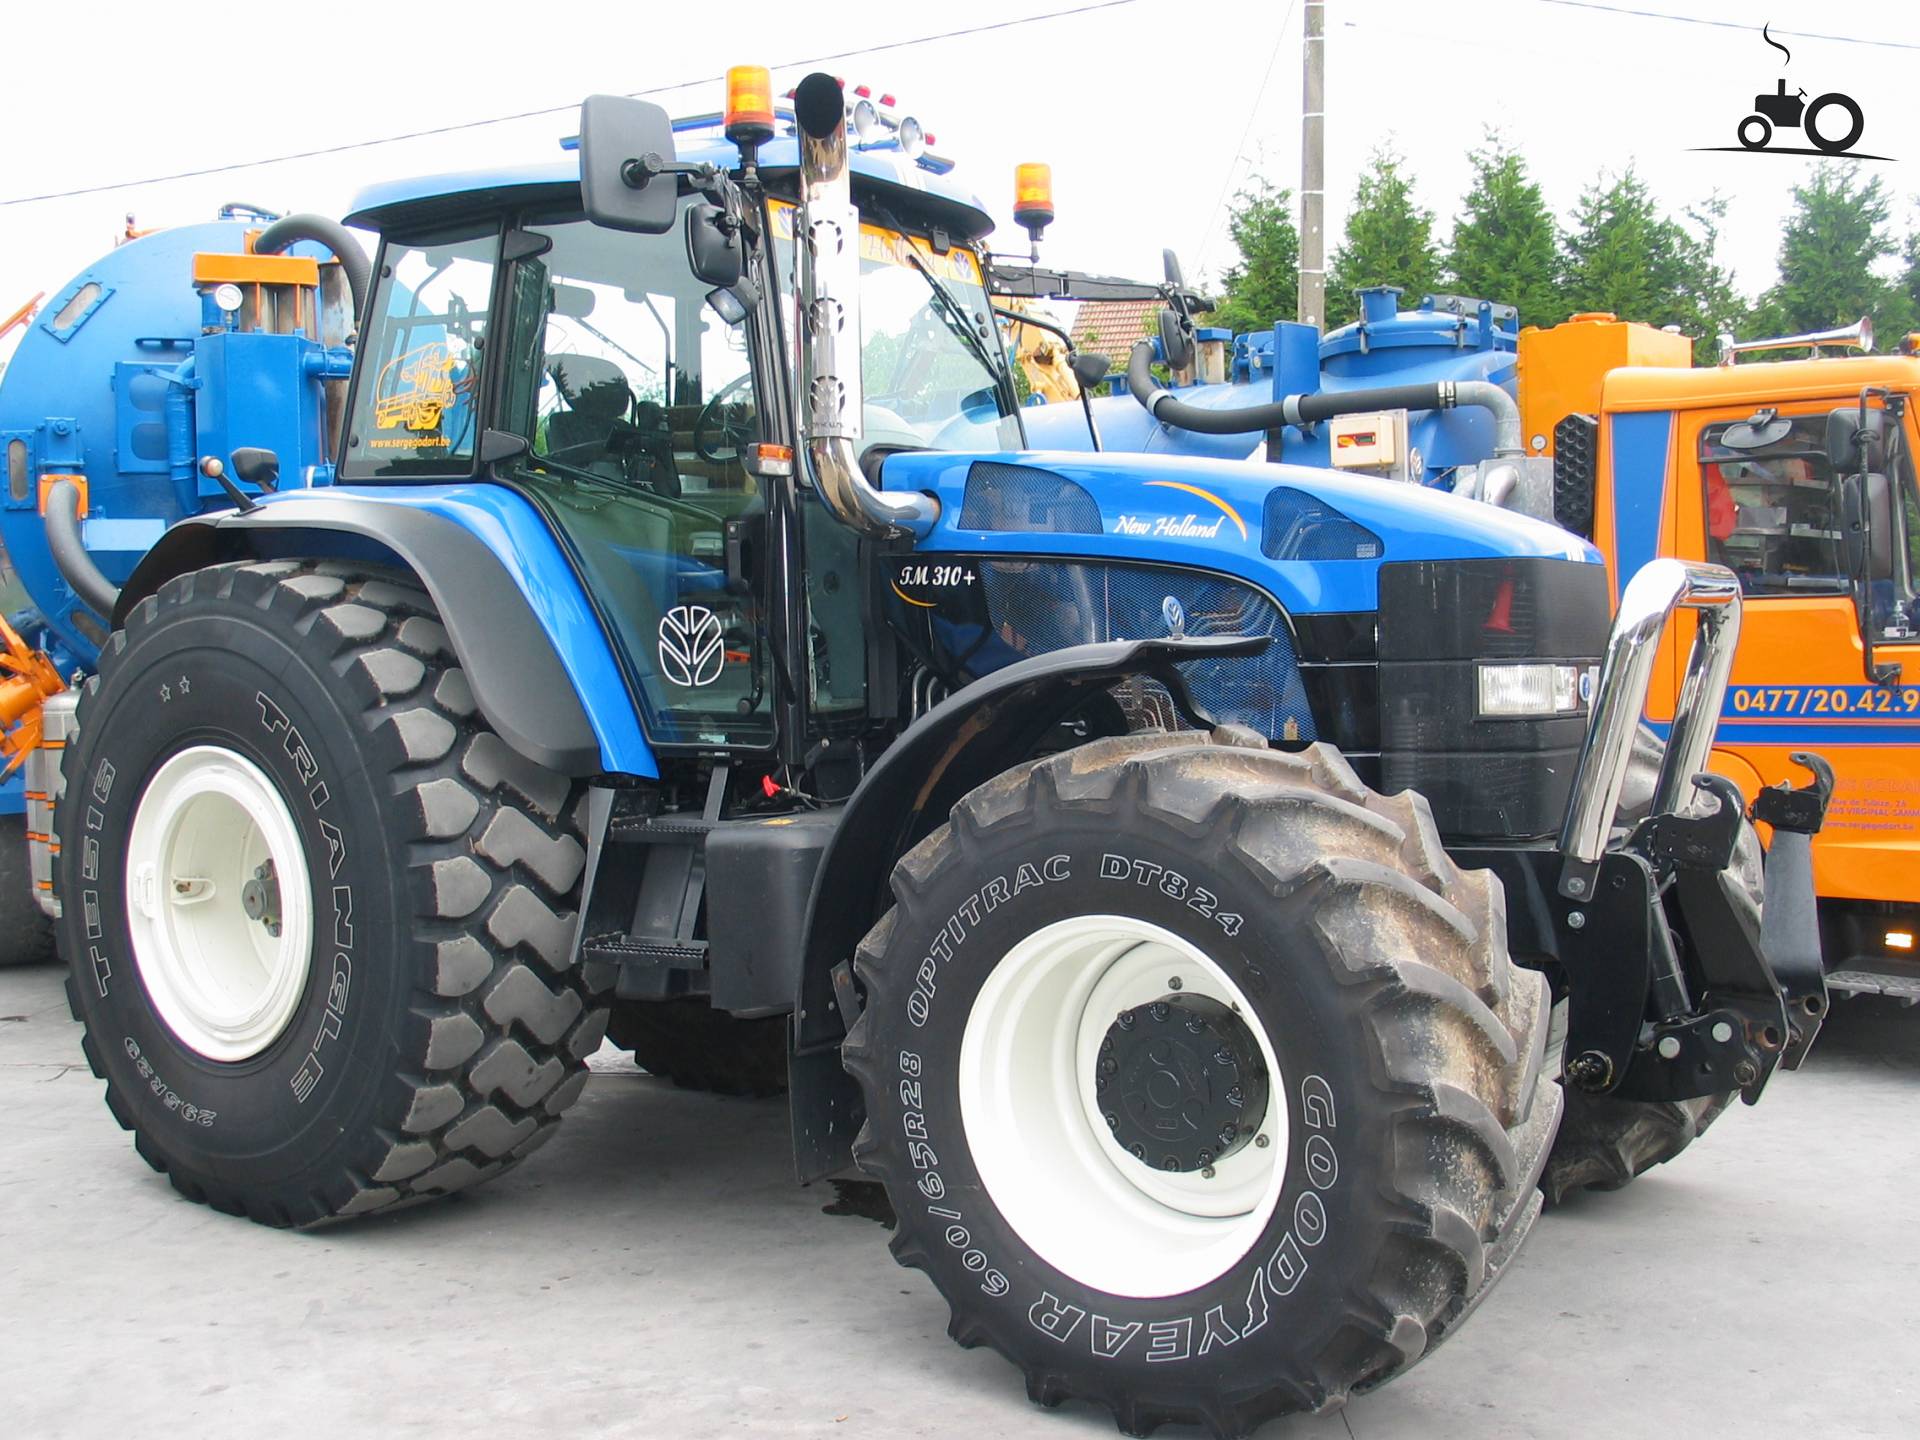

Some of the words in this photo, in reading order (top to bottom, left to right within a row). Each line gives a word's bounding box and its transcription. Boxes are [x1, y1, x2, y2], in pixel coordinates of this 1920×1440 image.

[900, 566, 929, 585] TM
[932, 566, 976, 586] 310+
[1113, 515, 1151, 535] New
[1153, 514, 1226, 538] Holland
[1733, 689, 1920, 714] 0477/20.42.9
[82, 757, 118, 998] TB516
[255, 691, 355, 1103] TRIANGLE
[907, 853, 1072, 1028] OPTITRAC
[1100, 853, 1245, 937] DT824
[124, 1036, 218, 1128] 29.5R29
[899, 1050, 1011, 1297] 600/65R28
[1027, 1075, 1338, 1363] GOODYEAR
